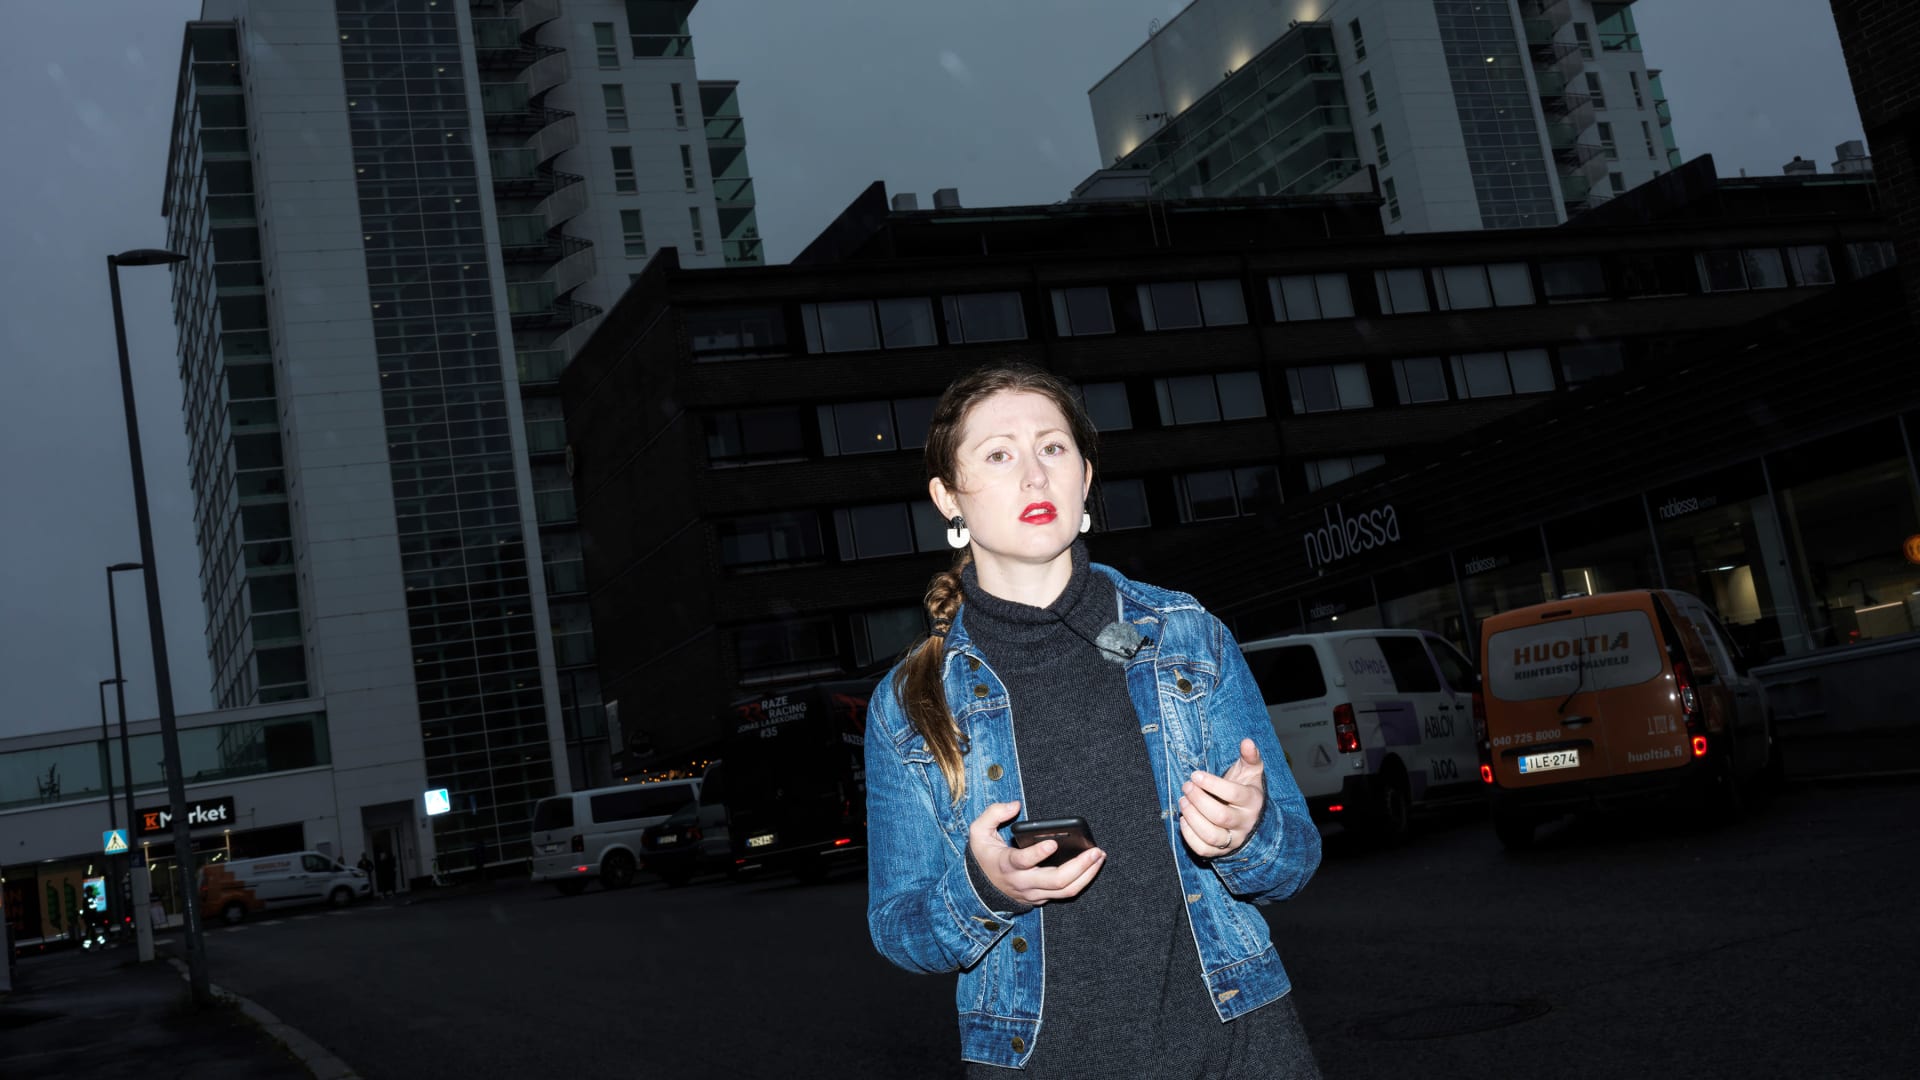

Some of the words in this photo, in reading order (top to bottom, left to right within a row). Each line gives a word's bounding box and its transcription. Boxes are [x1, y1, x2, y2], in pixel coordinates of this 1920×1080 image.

[1304, 503, 1401, 569] noblessa
[1513, 631, 1630, 666] HUOLTIA
[761, 695, 789, 711] RAZE
[768, 702, 808, 719] RACING
[1424, 714, 1455, 739] ABLOY
[1493, 736, 1511, 747] 040
[1514, 733, 1533, 745] 725
[1536, 729, 1562, 742] 8000
[1529, 753, 1577, 769] ILE-274
[1627, 745, 1683, 764] huoltia.fi
[160, 803, 227, 829] Mrket
